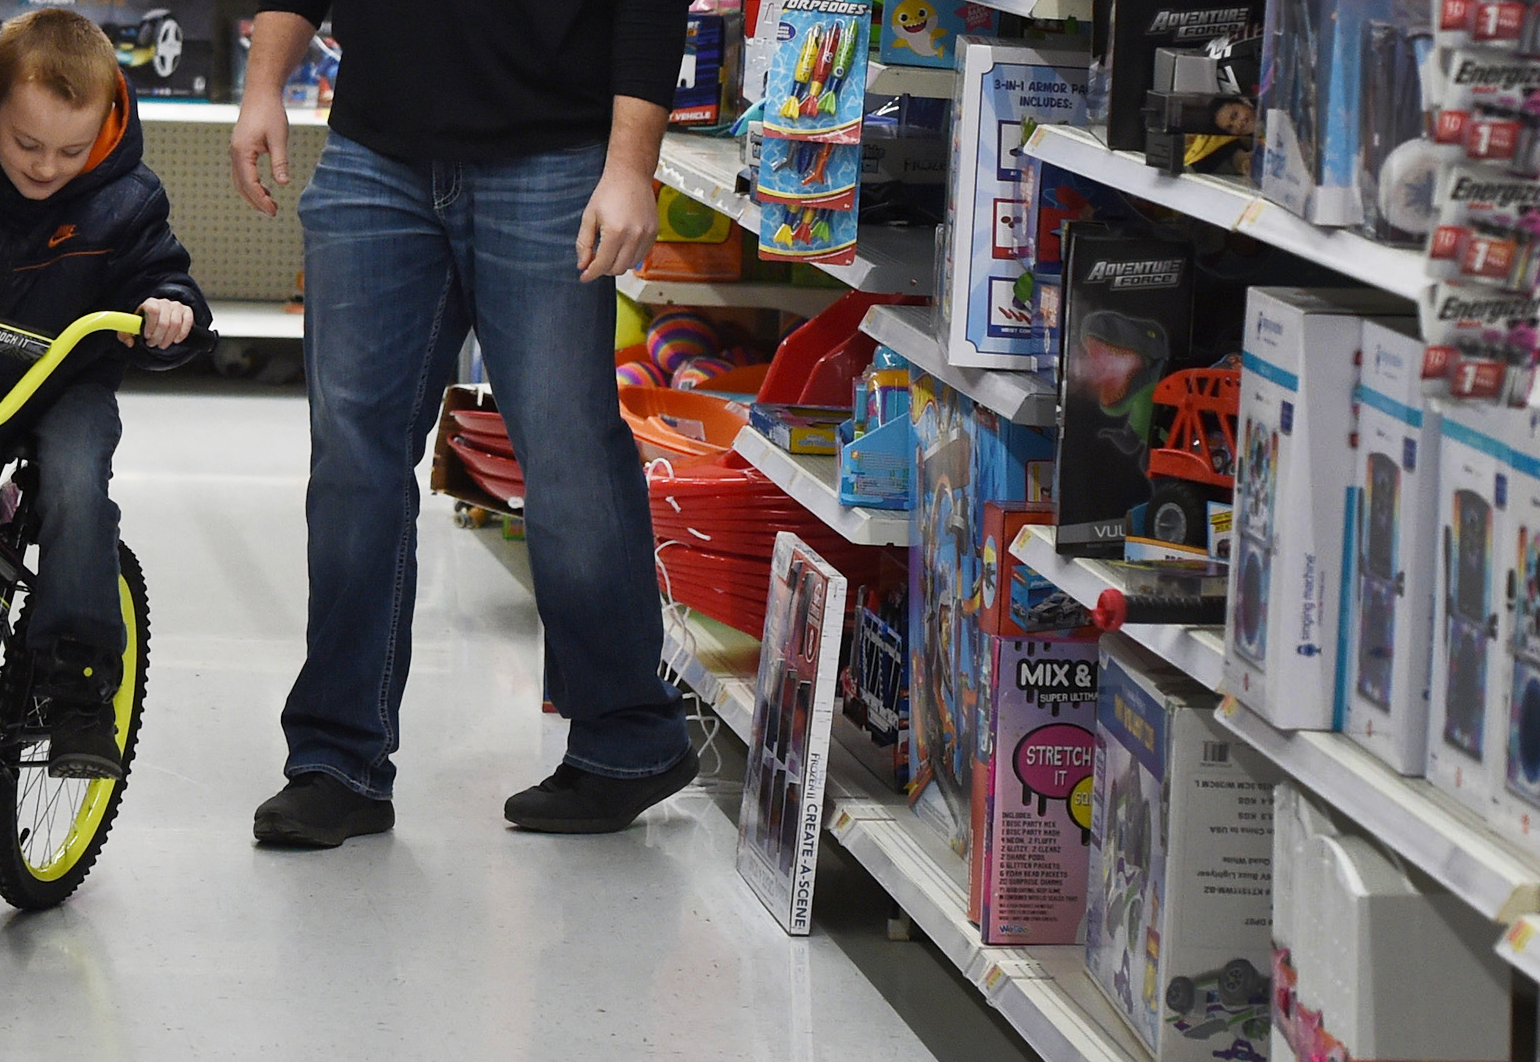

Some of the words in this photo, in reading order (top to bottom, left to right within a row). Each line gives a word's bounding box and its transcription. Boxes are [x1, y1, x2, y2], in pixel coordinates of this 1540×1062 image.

[1149, 7, 1250, 33] ADVENTURE
[1486, 5, 1499, 36] 1
[1178, 24, 1244, 39] FORCE
[1028, 80, 1068, 94] ARMOR
[1019, 96, 1073, 110] INCLUDES:
[1477, 124, 1491, 154] 1
[1473, 242, 1489, 270] 1
[1087, 260, 1185, 282] ADVENTURE
[1113, 273, 1181, 288] FORCE
[18, 336, 30, 348] IT
[1463, 365, 1477, 394] 1
[1304, 552, 1317, 601] machine
[1020, 663, 1070, 687] MIX
[1074, 663, 1091, 687] &
[1039, 692, 1069, 703] SUPER
[1026, 745, 1092, 767] STRETCH
[807, 752, 821, 794] FROZEN
[1054, 770, 1067, 786] IT
[1022, 820, 1042, 828] PARTY
[1043, 820, 1057, 828] MIX
[1209, 826, 1228, 835] USA
[1240, 826, 1266, 836] China
[1022, 828, 1042, 836] PARTY
[1033, 862, 1061, 870] PACKETS
[1222, 856, 1247, 865] White
[1247, 856, 1271, 866] Quad
[1196, 870, 1236, 880] Lightyear
[1237, 872, 1258, 881] Buzz
